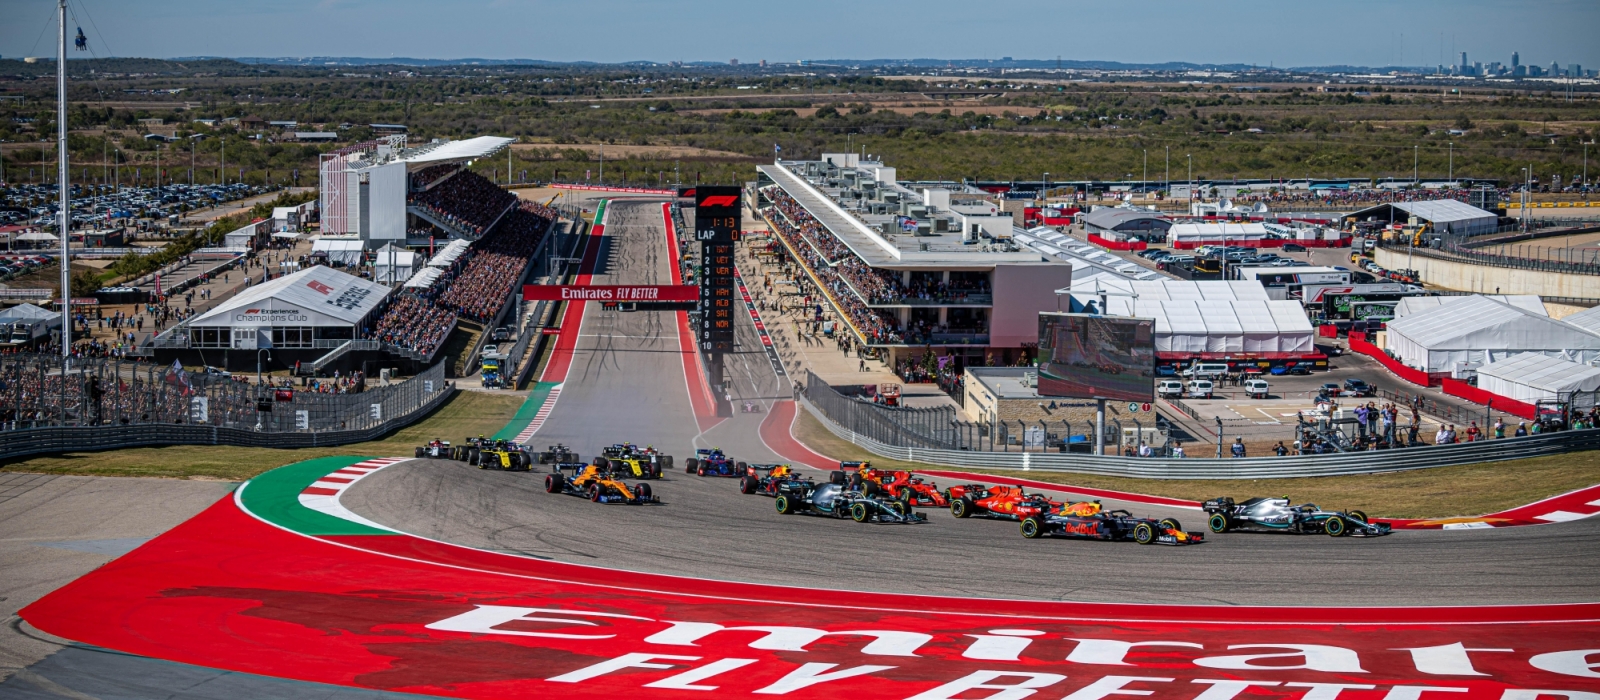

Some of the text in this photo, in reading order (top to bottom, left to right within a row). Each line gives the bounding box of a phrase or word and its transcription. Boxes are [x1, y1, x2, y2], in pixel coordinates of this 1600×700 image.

[713, 217, 735, 227] 1:13
[698, 230, 738, 240] LAP 0
[705, 246, 710, 254] 1
[705, 257, 729, 265] 2 VET
[705, 267, 729, 275] 3 VER
[705, 278, 710, 286] 4
[561, 287, 659, 299] Emirates FLY BETTER
[705, 299, 729, 307] 6 ALB
[236, 314, 308, 322] Champions Club
[705, 310, 729, 318] 7 SAI
[705, 331, 710, 339] 9
[702, 342, 711, 350] 10
[1234, 505, 1247, 514] 77
[544, 652, 1600, 700] FLY BETT
